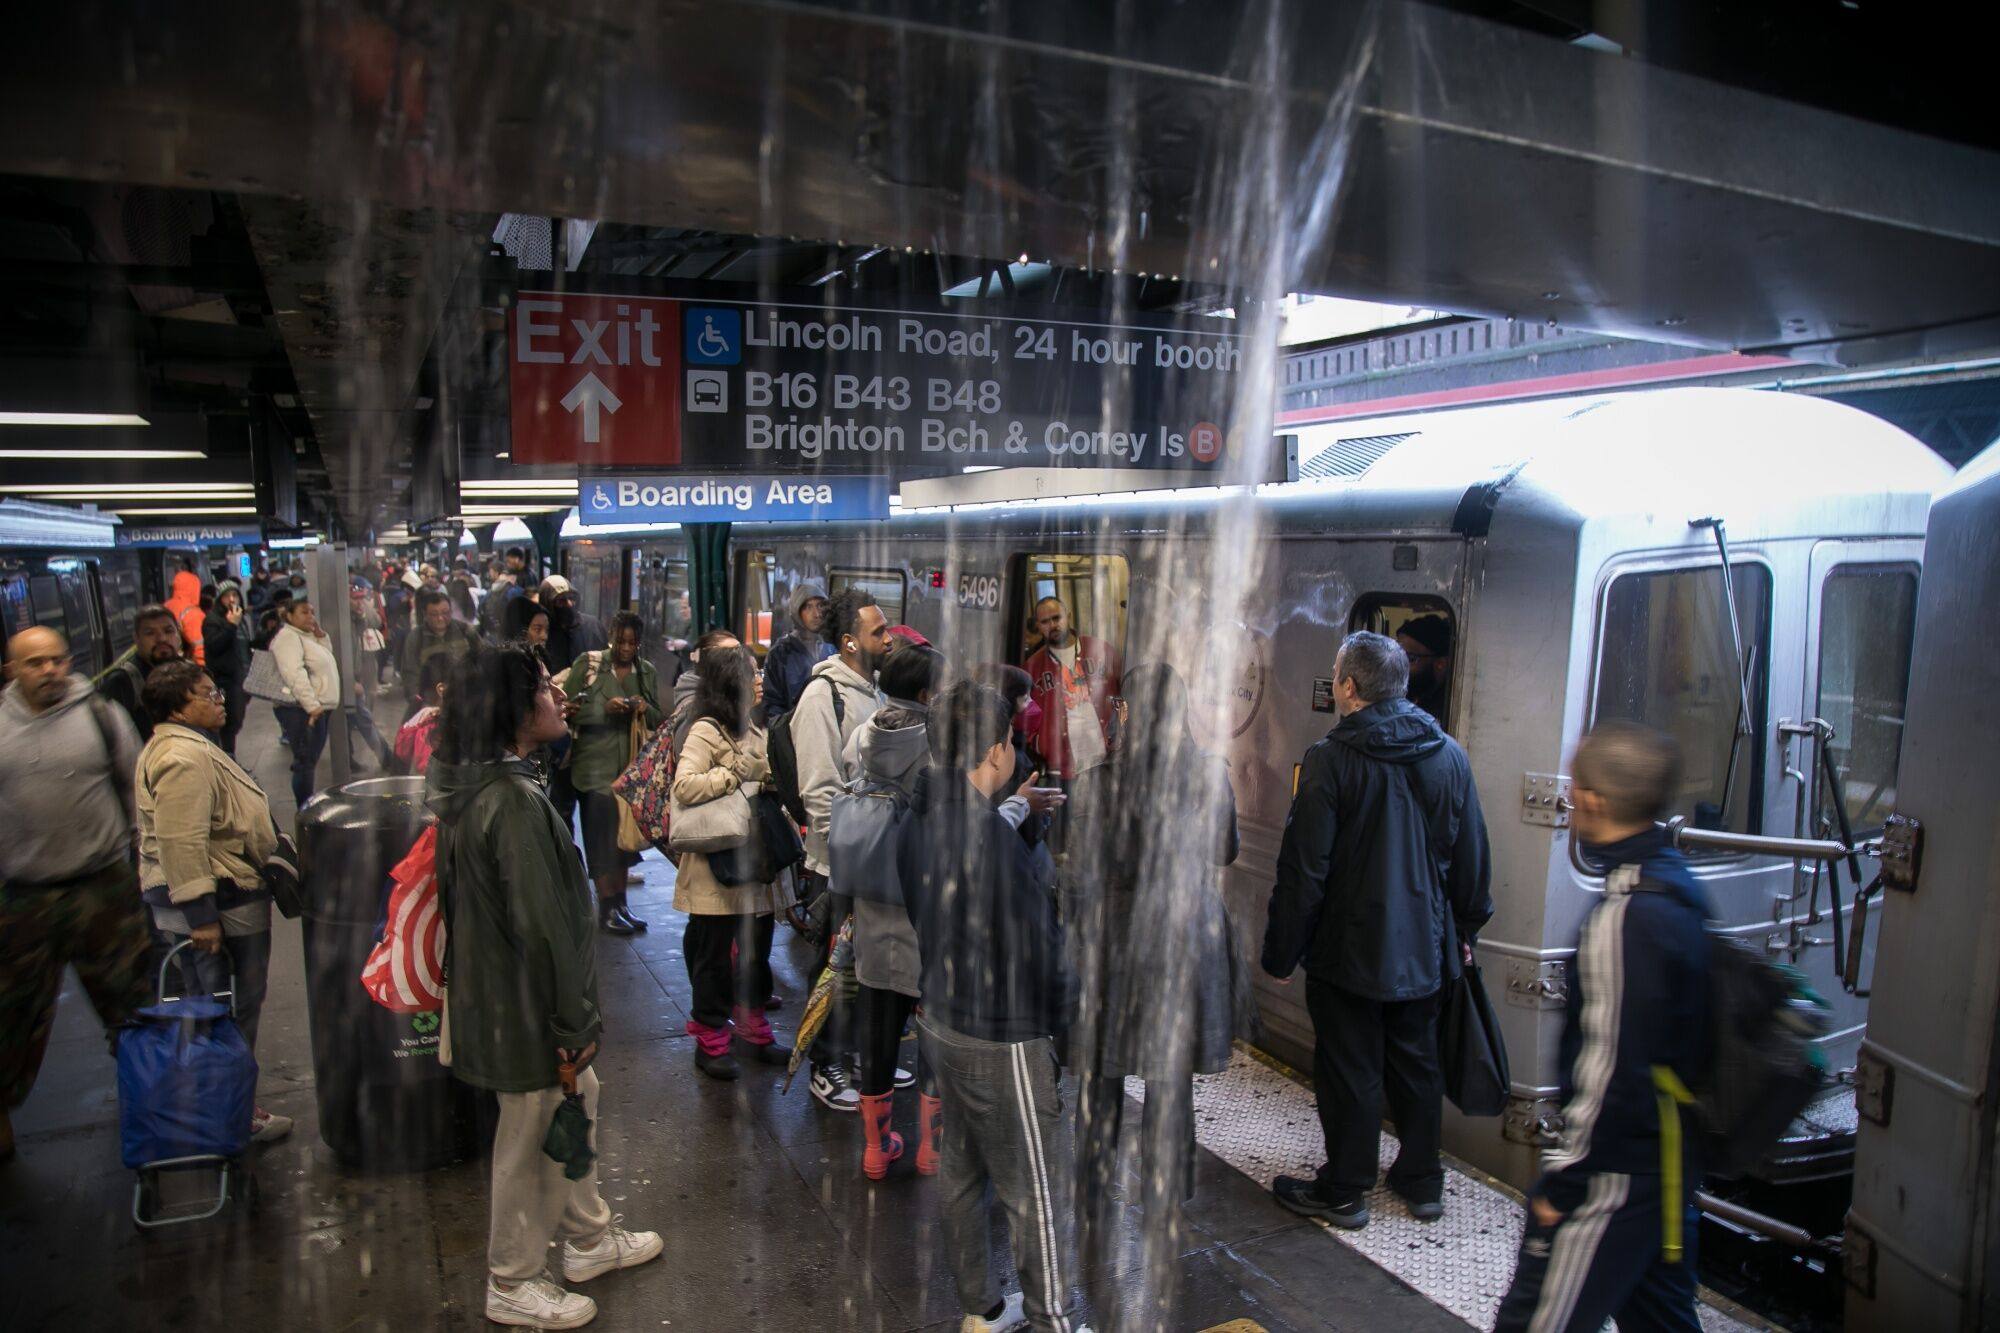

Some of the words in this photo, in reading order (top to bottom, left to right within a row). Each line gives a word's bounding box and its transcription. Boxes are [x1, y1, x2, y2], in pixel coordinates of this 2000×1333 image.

[516, 300, 662, 367] Exit
[745, 310, 882, 351] Lincoln
[899, 318, 1000, 364] Road,
[1013, 325, 1058, 361] 24
[1072, 330, 1143, 366] hour
[1155, 335, 1242, 372] booth
[745, 371, 818, 409] B16
[834, 374, 912, 411] B43
[927, 377, 1001, 413] B48
[745, 414, 904, 459] Brighton
[921, 419, 989, 454] Bch
[1003, 420, 1029, 454] &
[1044, 421, 1148, 463] Coney
[1160, 425, 1184, 458] Is
[1197, 430, 1214, 454] B
[618, 480, 753, 511] Boarding
[766, 479, 833, 505] Area
[131, 528, 197, 543] Boarding
[200, 528, 233, 540] Area
[959, 574, 999, 608] 5496
[392, 1049, 410, 1058] We
[411, 1046, 440, 1057] Recy
[400, 1038, 419, 1047] You
[420, 1035, 440, 1045] Can
